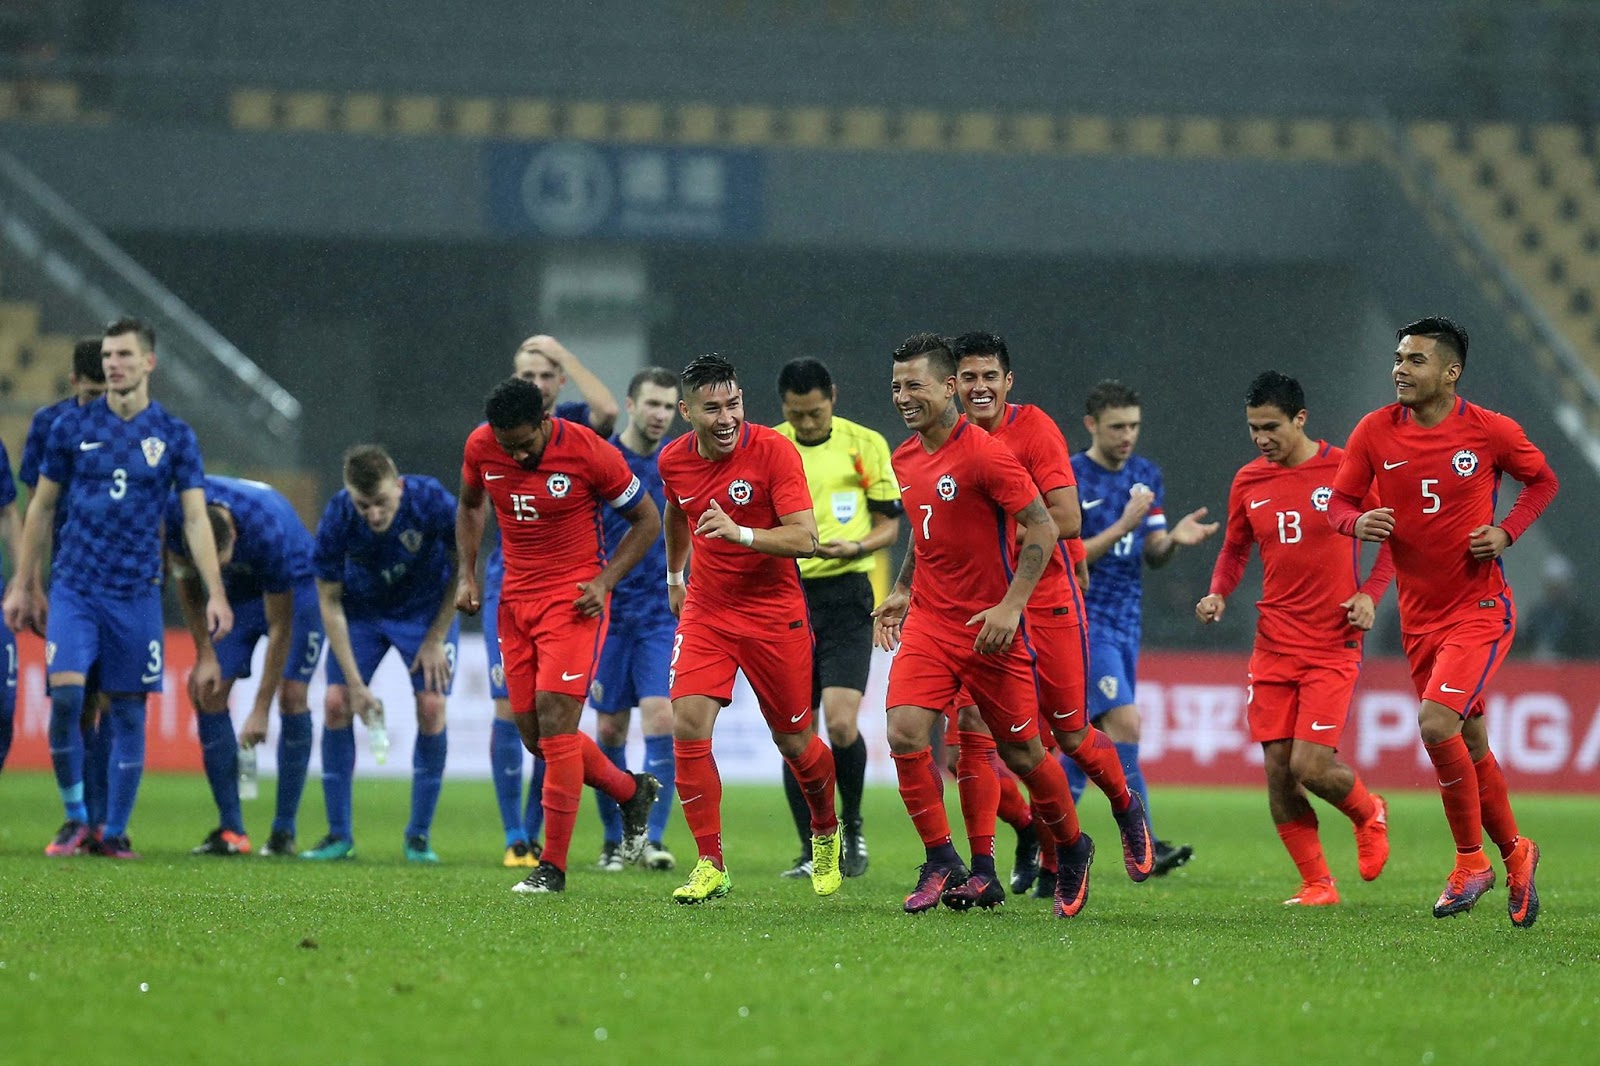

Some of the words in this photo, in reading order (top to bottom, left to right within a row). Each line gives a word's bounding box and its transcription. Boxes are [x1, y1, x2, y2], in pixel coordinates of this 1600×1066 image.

[109, 468, 127, 500] 3
[1421, 479, 1441, 514] 5
[510, 493, 539, 521] 15
[919, 504, 933, 540] 7
[1275, 510, 1302, 544] 13
[147, 639, 163, 674] 3
